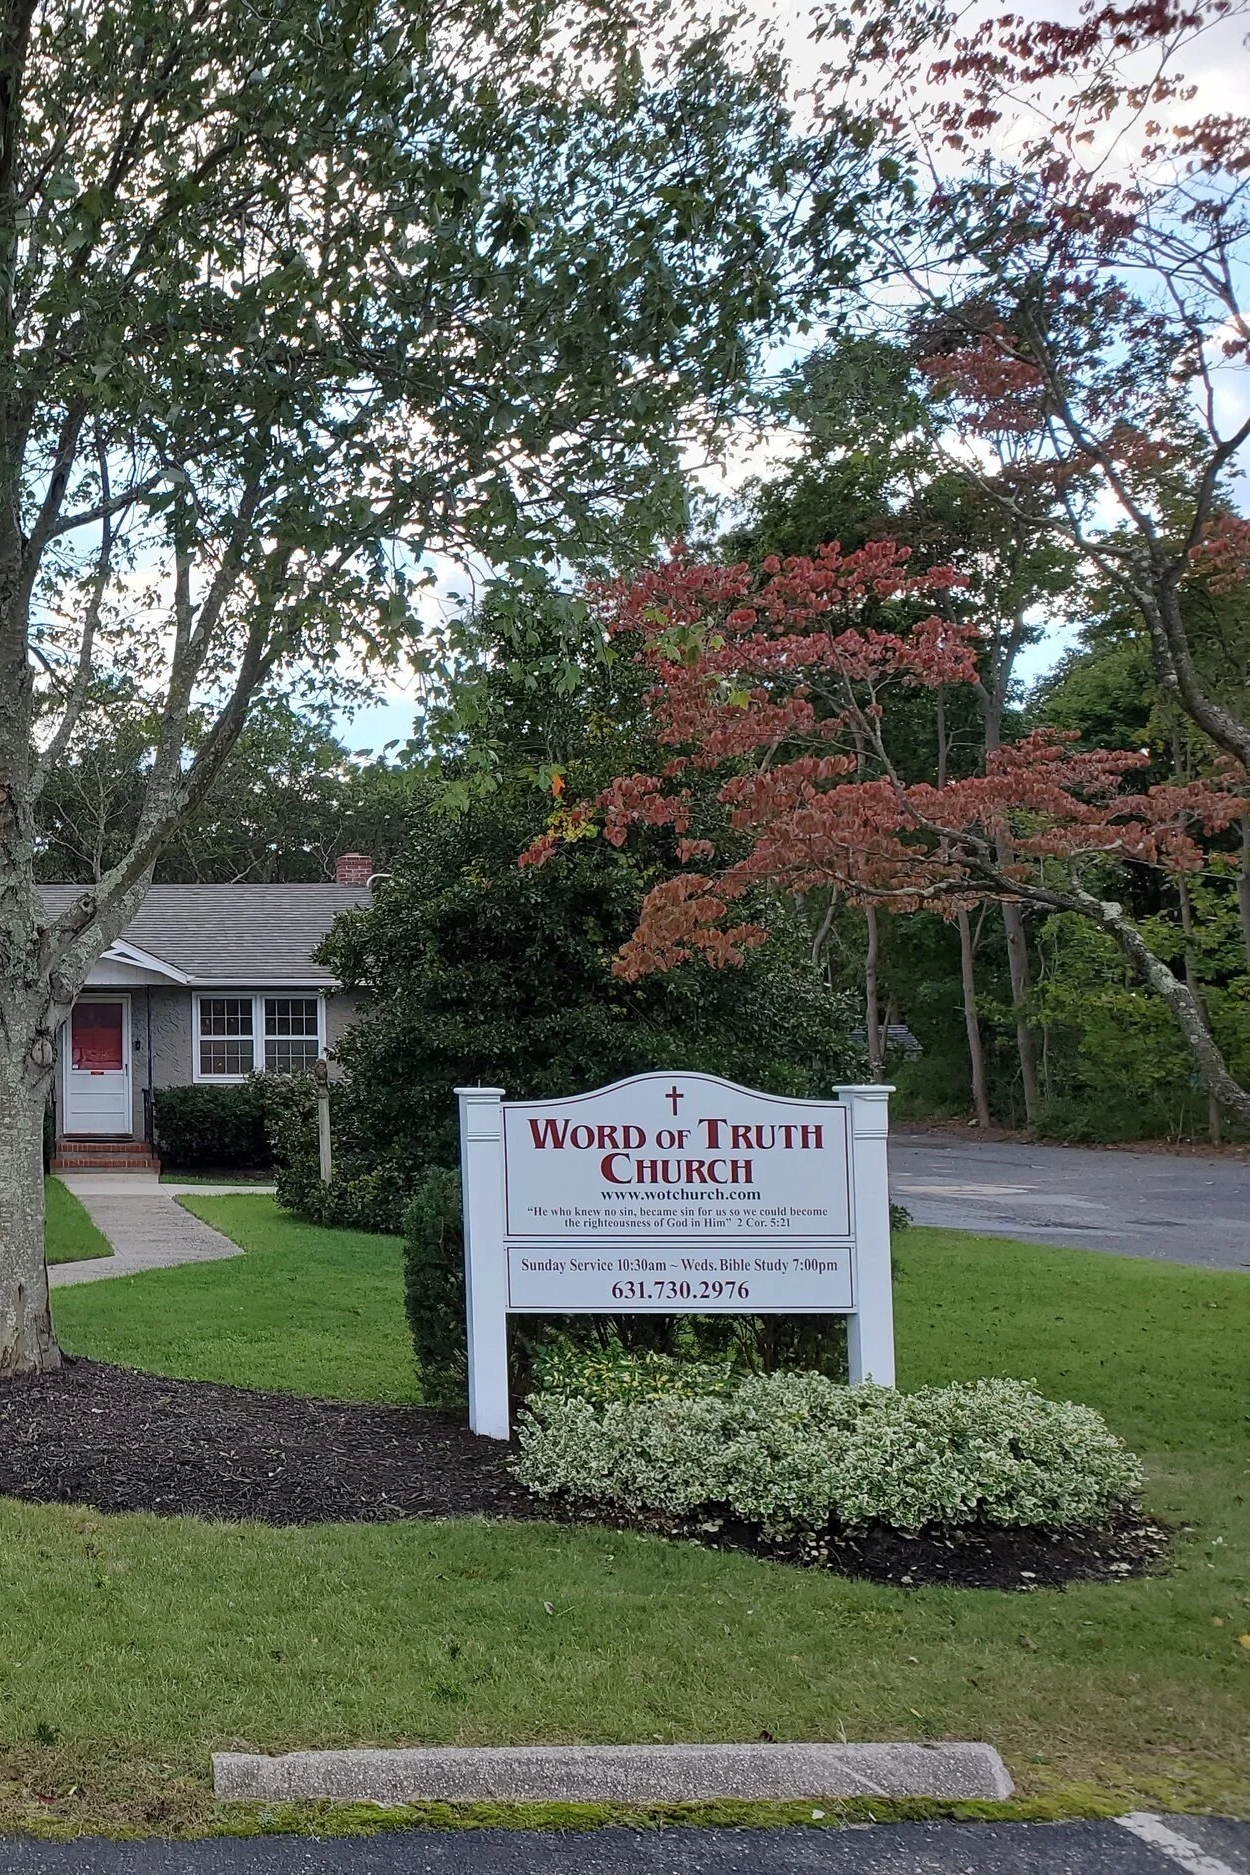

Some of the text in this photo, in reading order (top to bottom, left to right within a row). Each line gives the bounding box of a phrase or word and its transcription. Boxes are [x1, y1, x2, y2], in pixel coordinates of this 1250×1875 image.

[527, 1119, 824, 1149] WORD OF TRUTH
[600, 1153, 754, 1184] CHURCH
[600, 1188, 761, 1201] www.wotchurch.com
[527, 1206, 828, 1218] “He who knew no sin, became sin for us so we could become
[564, 1218, 791, 1230] the righteousness of God in Him” 2 Cor. 5:21
[521, 1258, 566, 1275] Sunday
[569, 1258, 614, 1272] Service
[617, 1258, 667, 1272] 10:30am
[681, 1258, 718, 1272] Weds.
[719, 1258, 751, 1272] Bible
[754, 1258, 789, 1275] Study
[792, 1258, 838, 1275] 7:00pm
[611, 1280, 750, 1300] 631.730.2976
